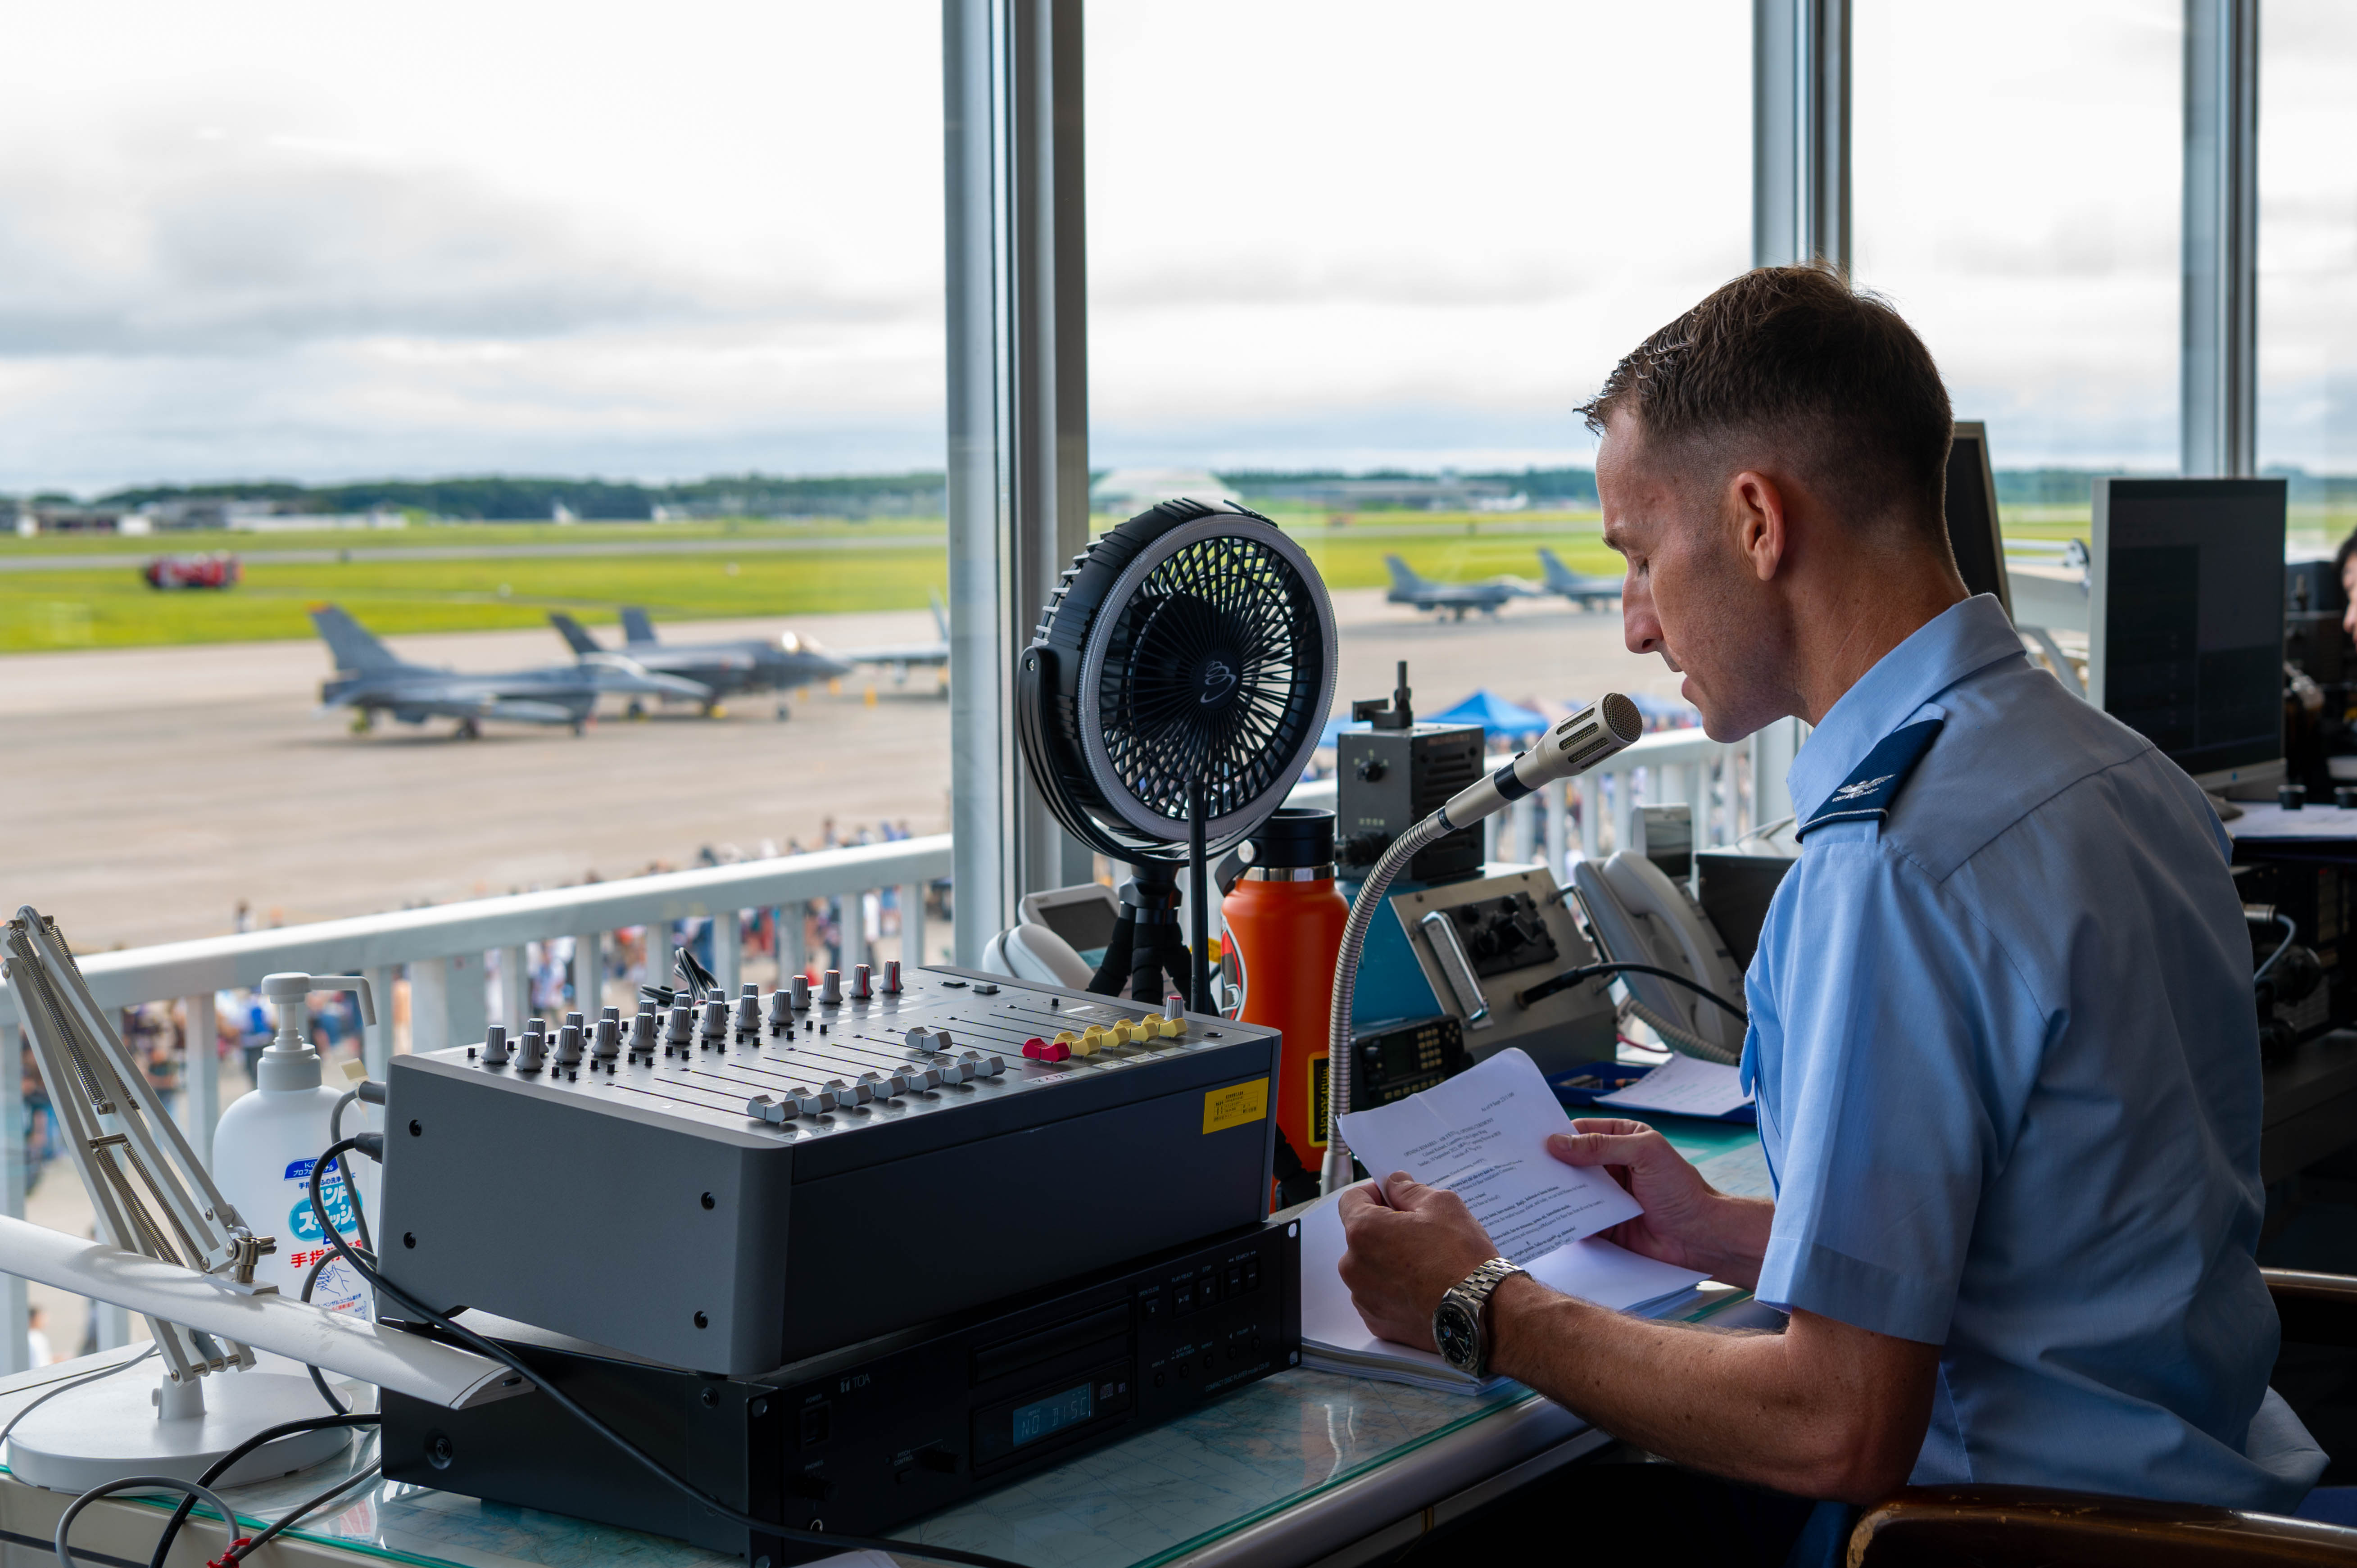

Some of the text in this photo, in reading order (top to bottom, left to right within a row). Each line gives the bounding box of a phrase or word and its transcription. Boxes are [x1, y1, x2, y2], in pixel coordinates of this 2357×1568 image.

[1100, 1060, 1124, 1068] CD
[1202, 1264, 1212, 1272] STOP
[1171, 1272, 1193, 1283] PLAY/READY
[1138, 1285, 1160, 1297] OPEN/CLOSE
[852, 1373, 871, 1387] TOA
[1205, 1379, 1224, 1392] COMPACT
[1224, 1376, 1233, 1385] DISC
[1233, 1370, 1247, 1381] PLAYER
[1021, 1396, 1087, 1437] NO DISC
[804, 1459, 825, 1470] PHONES
